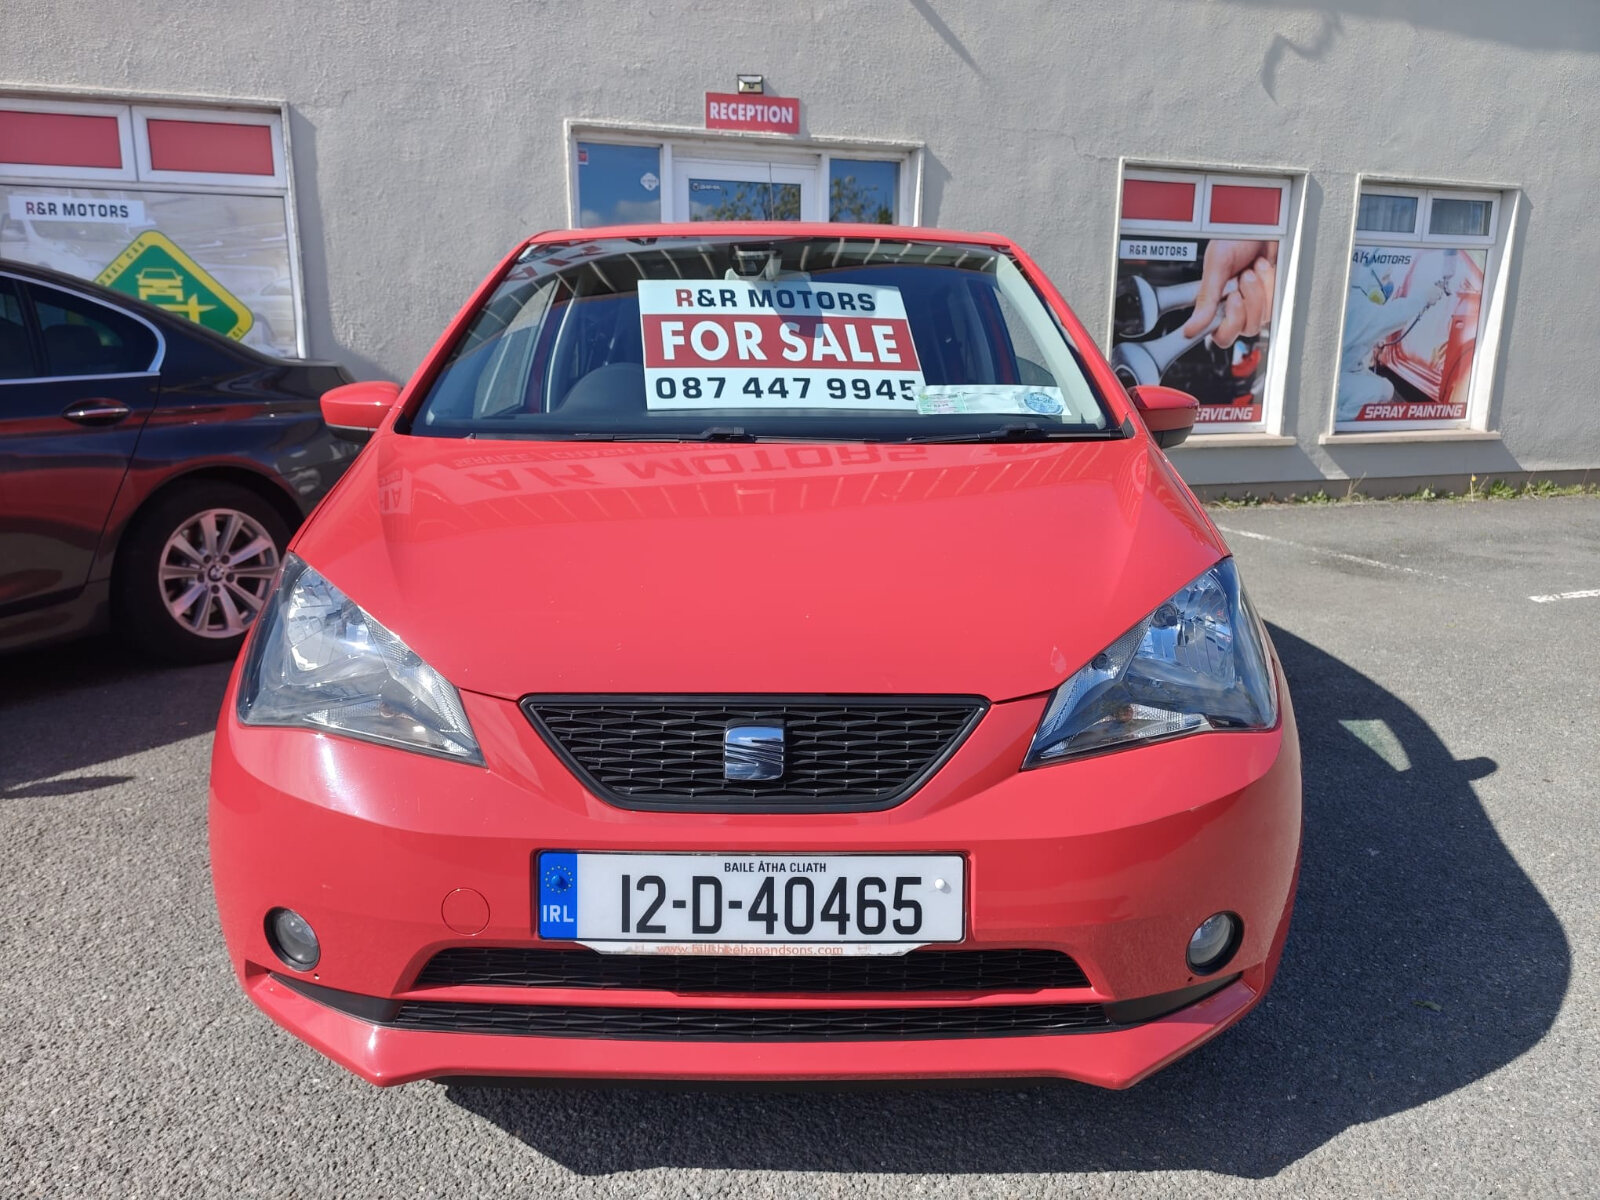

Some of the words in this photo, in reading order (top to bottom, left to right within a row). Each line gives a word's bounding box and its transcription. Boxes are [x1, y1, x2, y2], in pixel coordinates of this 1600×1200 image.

[709, 101, 793, 124] RECEPTION
[25, 201, 58, 216] R&R
[62, 203, 129, 219] MOTORS
[1129, 244, 1147, 256] R&R
[1150, 245, 1188, 257] MOTORS
[1373, 254, 1412, 265] MOTORS
[675, 289, 738, 307] R&R
[748, 289, 876, 312] MOTORS
[660, 321, 767, 361] FOR
[781, 322, 902, 363] SALE
[655, 377, 727, 399] 087
[742, 377, 811, 399] 447
[826, 378, 916, 401] 9945
[1196, 407, 1253, 421] RVICING
[1364, 404, 1404, 418] SPRAY
[1407, 404, 1463, 418] PAINTING
[724, 862, 755, 873] BAILE
[789, 862, 827, 873] CLIATH
[543, 904, 574, 923] IRL
[621, 874, 923, 935] 12-D-40465
